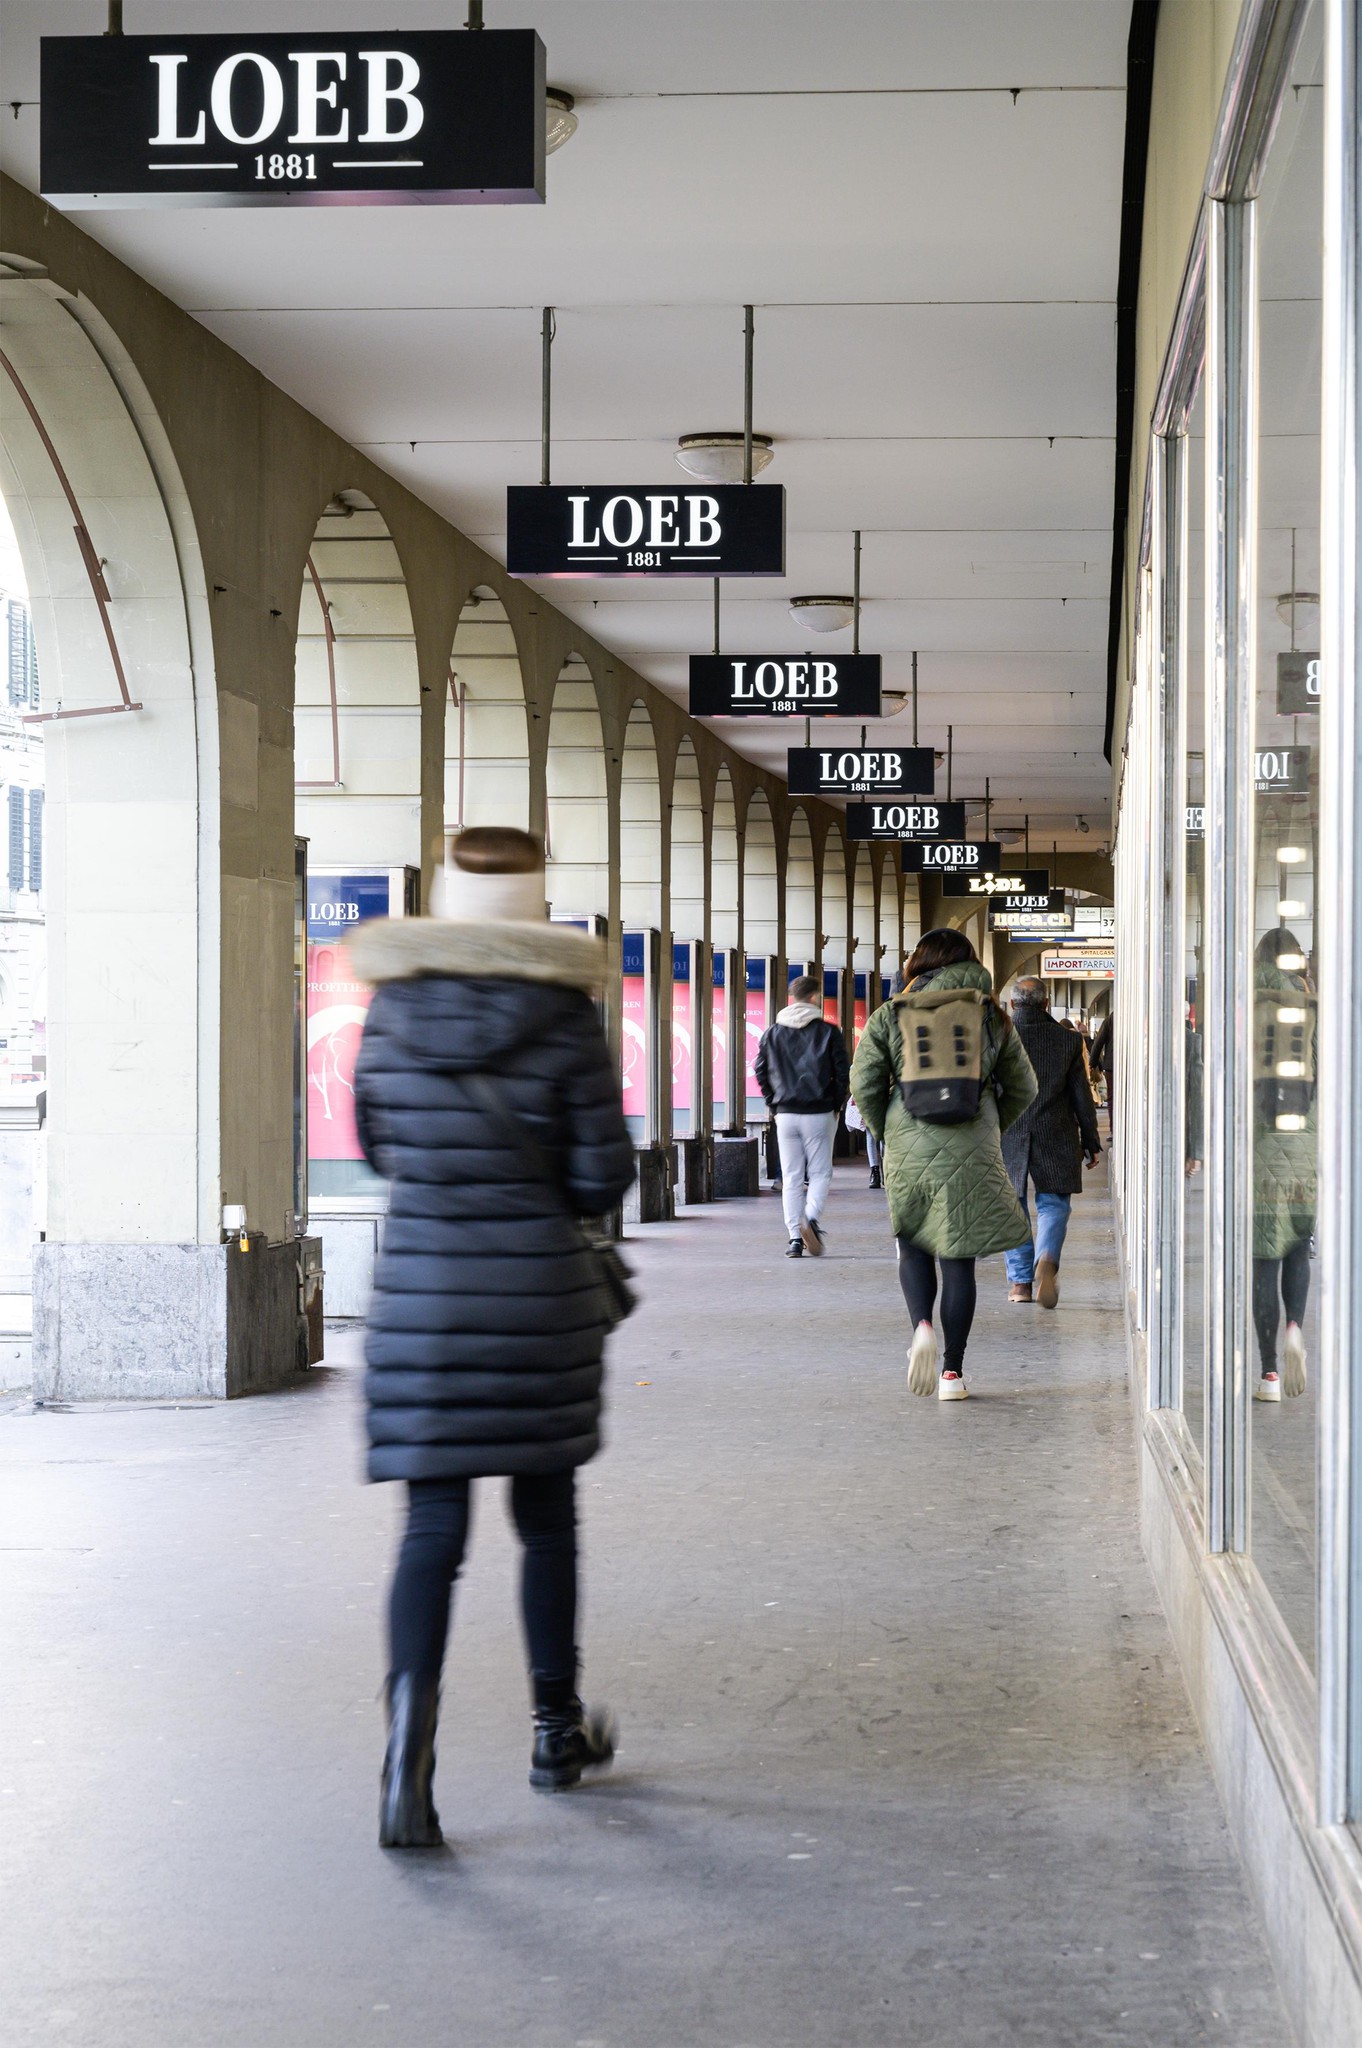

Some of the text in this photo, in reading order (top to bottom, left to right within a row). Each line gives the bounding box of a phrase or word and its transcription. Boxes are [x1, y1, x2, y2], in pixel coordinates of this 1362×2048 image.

[149, 51, 424, 145] LOEB
[254, 154, 318, 180] 1881
[567, 495, 722, 547] LOEB
[626, 552, 662, 567] 1881
[730, 662, 839, 698] LOEB
[771, 701, 798, 712] 1881
[819, 753, 903, 781] LOEB
[850, 782, 871, 792] 1881
[872, 806, 940, 830] LOEB
[897, 830, 914, 838] 1881
[922, 845, 979, 865] LOEB
[1005, 896, 1049, 907] LOEB
[309, 903, 360, 920] LOEB
[1103, 919, 1115, 927] 37
[1047, 960, 1115, 970] IMPORTPARFUM
